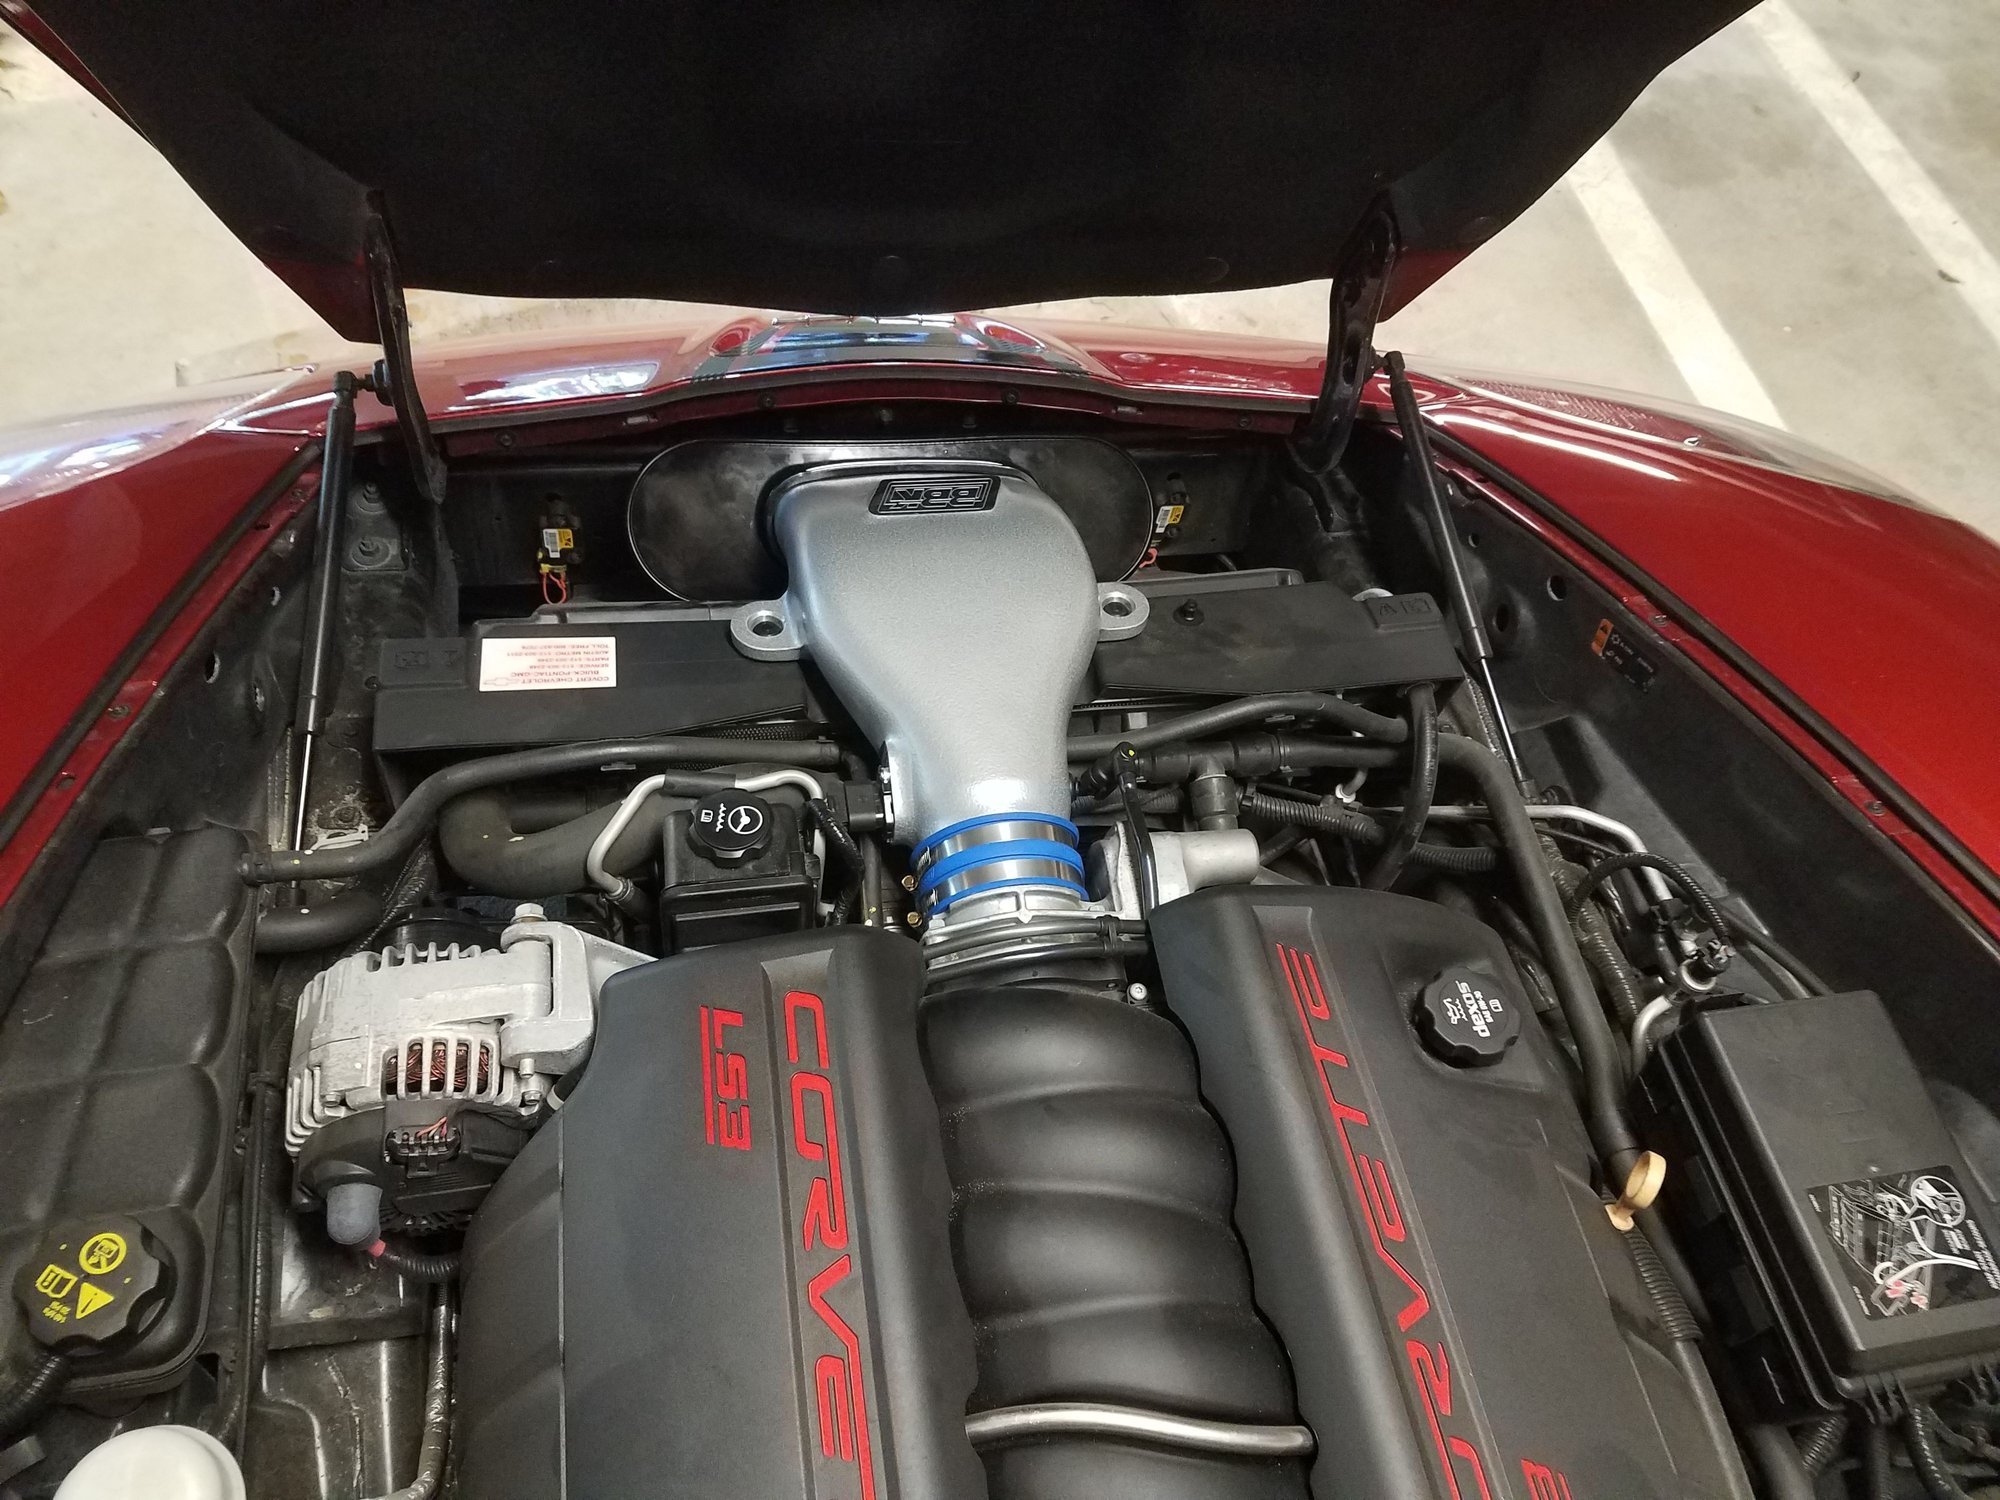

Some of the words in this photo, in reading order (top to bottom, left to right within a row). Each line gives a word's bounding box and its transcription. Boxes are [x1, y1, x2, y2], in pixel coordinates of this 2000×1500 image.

[884, 484, 986, 510] BBK
[1456, 981, 1491, 1038] dexos
[712, 1007, 752, 1151] LS3
[784, 990, 876, 1500] CORVE
